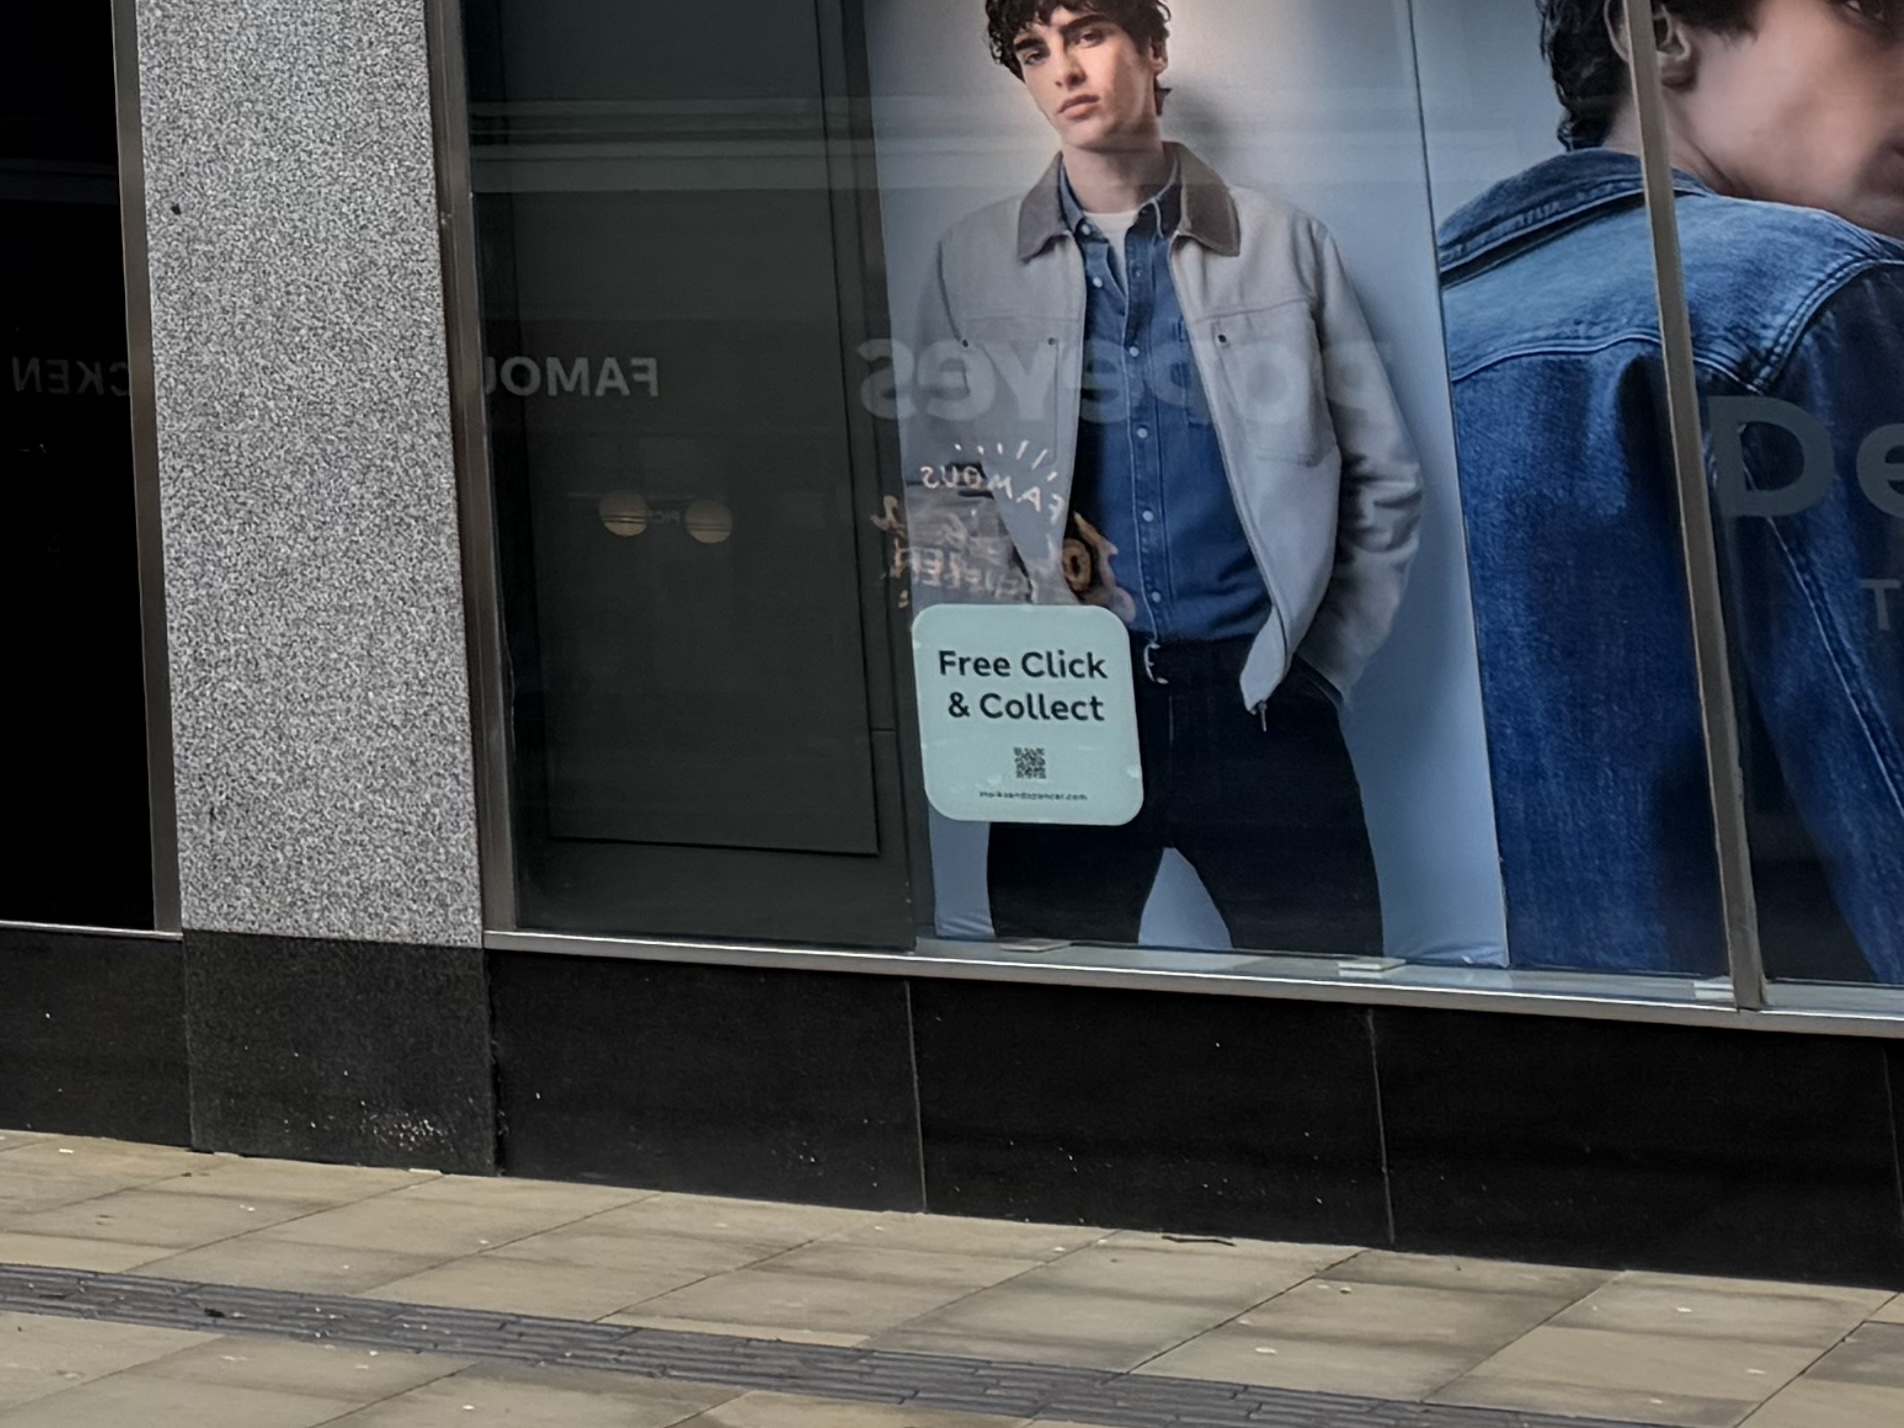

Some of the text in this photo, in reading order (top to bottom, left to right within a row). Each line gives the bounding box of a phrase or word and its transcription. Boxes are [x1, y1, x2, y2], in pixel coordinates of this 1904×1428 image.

[938, 648, 1109, 680] Free Click
[946, 691, 1106, 722] & Collect
